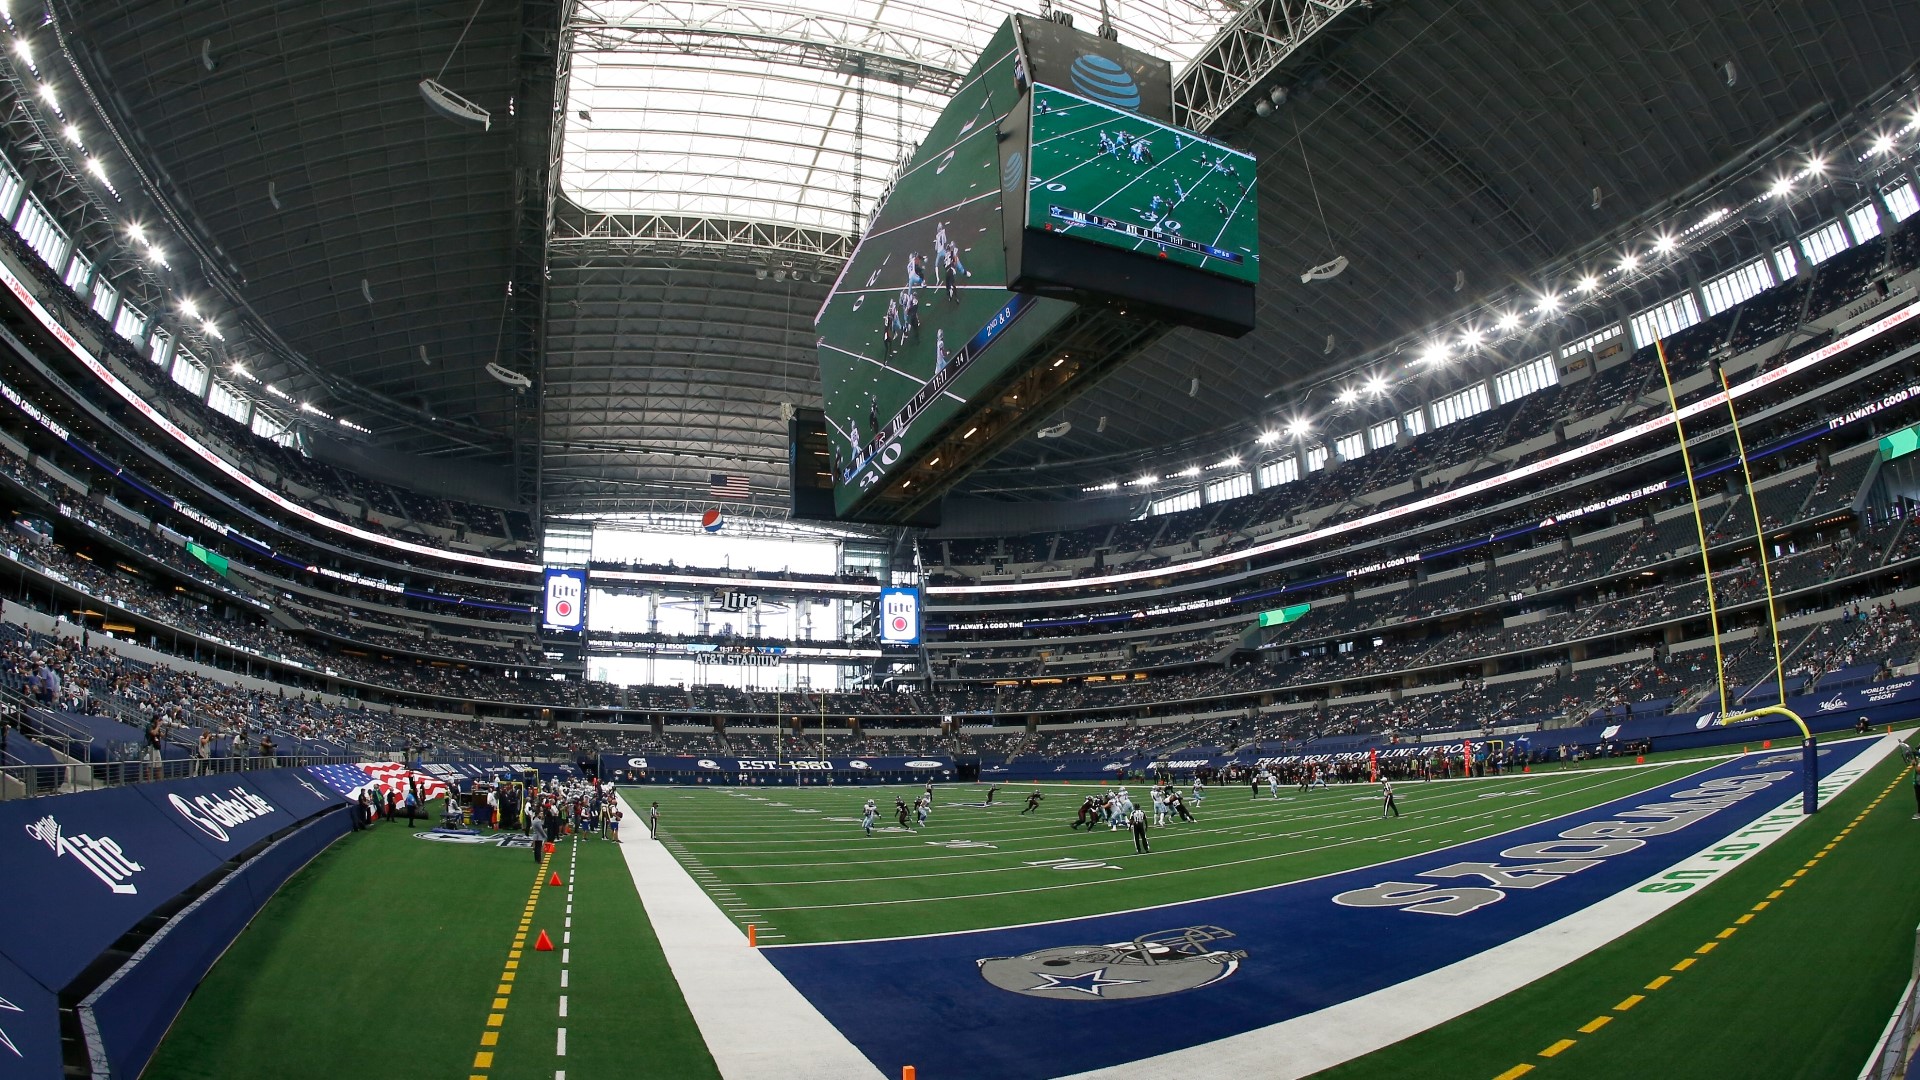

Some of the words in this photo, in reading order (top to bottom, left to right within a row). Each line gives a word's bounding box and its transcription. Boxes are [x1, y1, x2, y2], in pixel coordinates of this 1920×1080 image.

[1073, 211, 1086, 222] DAL
[1126, 224, 1138, 234] ATL
[892, 414, 904, 433] ATL
[932, 369, 947, 390] 11:17
[956, 353, 964, 366] :14
[986, 319, 998, 336] 2ND
[1000, 314, 1005, 324] &
[1006, 308, 1010, 318] 8
[2, 384, 20, 406] WORLD
[20, 400, 41, 420] CASINO
[50, 421, 70, 441] RESORT
[1829, 417, 1845, 430] IT'S
[1845, 404, 1876, 424] ALWAYS
[1877, 403, 1883, 411] A
[1884, 391, 1908, 407] GOOD
[1582, 501, 1607, 513] WORLD
[1606, 494, 1630, 506] CASINO
[1641, 481, 1668, 495] RESORT
[1346, 568, 1358, 578] IT'S
[1358, 563, 1381, 575] ALWAYS
[1386, 558, 1405, 568] GOOD
[1406, 554, 1420, 565] TIME
[552, 584, 578, 598] Lite
[720, 591, 758, 611] Lite
[888, 602, 912, 615] Lite
[695, 653, 725, 665] AT&T
[727, 655, 780, 667] STADIUM
[1860, 687, 1886, 695] WORLD
[1886, 682, 1913, 691] CASINO
[1869, 693, 1896, 702] RESORT
[1716, 708, 1747, 718] United
[738, 760, 782, 770] EST.
[791, 761, 834, 770] 1960
[1254, 756, 1300, 765] THANK
[1300, 754, 1332, 763] YOU
[1332, 750, 1381, 760] FRONT
[1380, 748, 1418, 758] LINE
[1418, 742, 1484, 756] HEROS
[195, 793, 250, 828] Globe
[228, 786, 275, 818] Life
[25, 814, 58, 851] Miller
[1737, 814, 1802, 838] ALL
[1332, 770, 1794, 915] COWBOYS
[1701, 842, 1760, 861] OF
[56, 824, 142, 894] Lite
[1637, 869, 1719, 893] US
